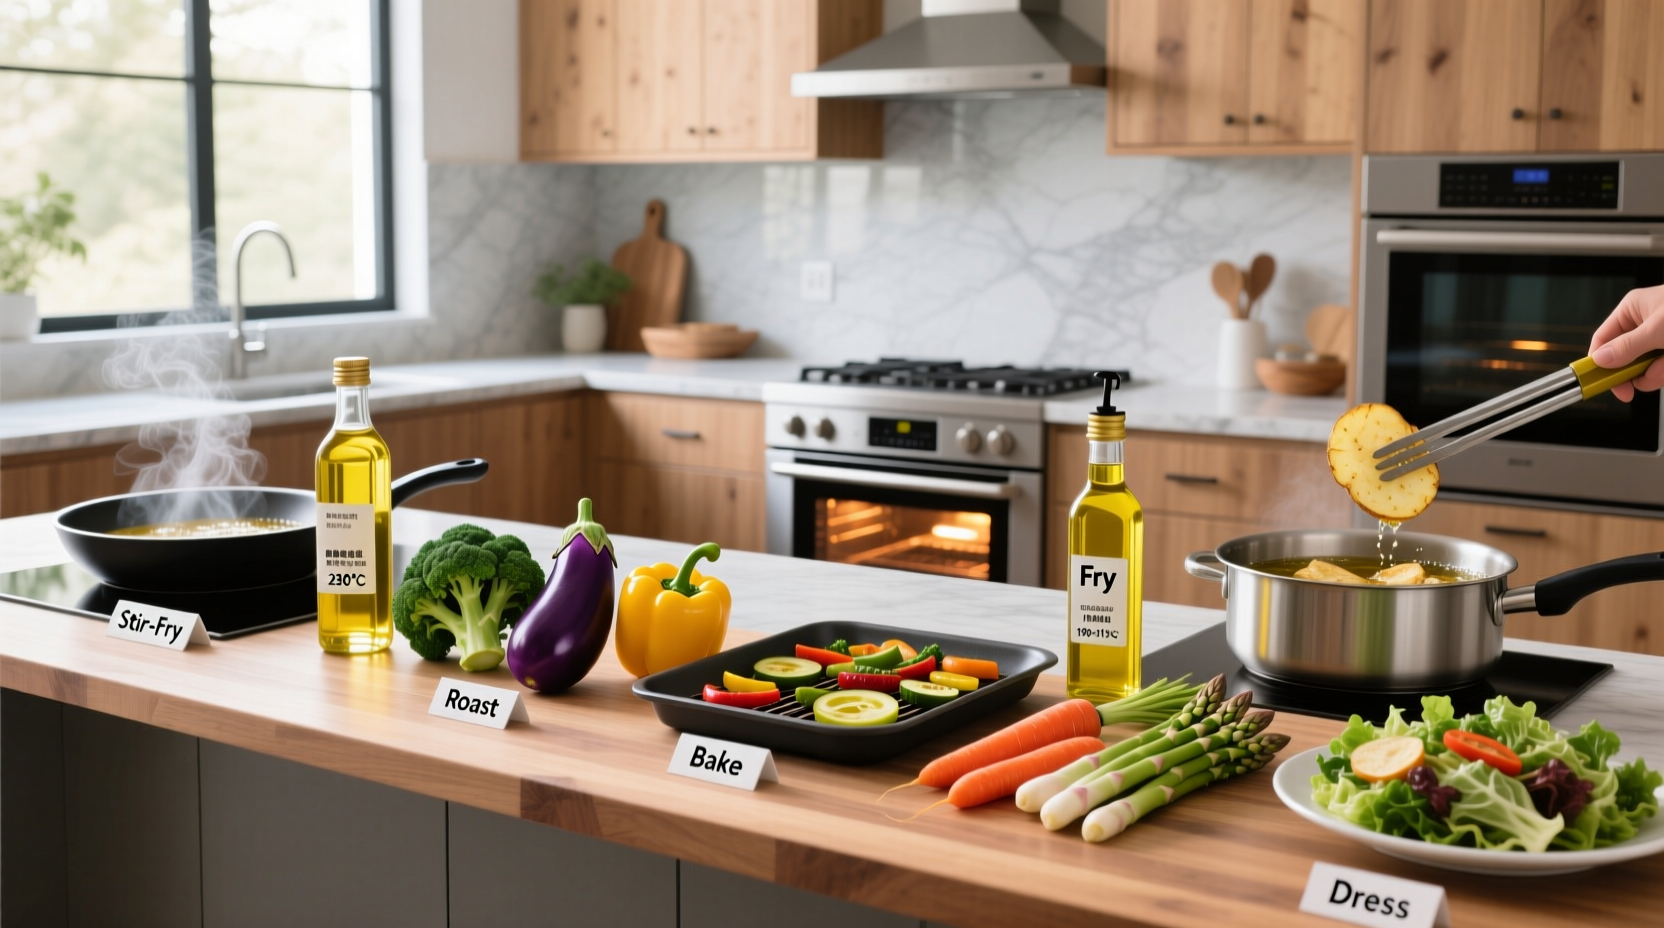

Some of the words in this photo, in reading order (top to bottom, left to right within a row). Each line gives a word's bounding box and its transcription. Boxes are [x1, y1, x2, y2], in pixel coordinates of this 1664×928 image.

[328, 573, 366, 587] 230°C
[1080, 564, 1117, 595] Fry
[118, 609, 183, 645] Stir-Fry
[444, 688, 500, 718] Roast
[689, 745, 743, 776] Bake
[1329, 878, 1410, 919] Dress
